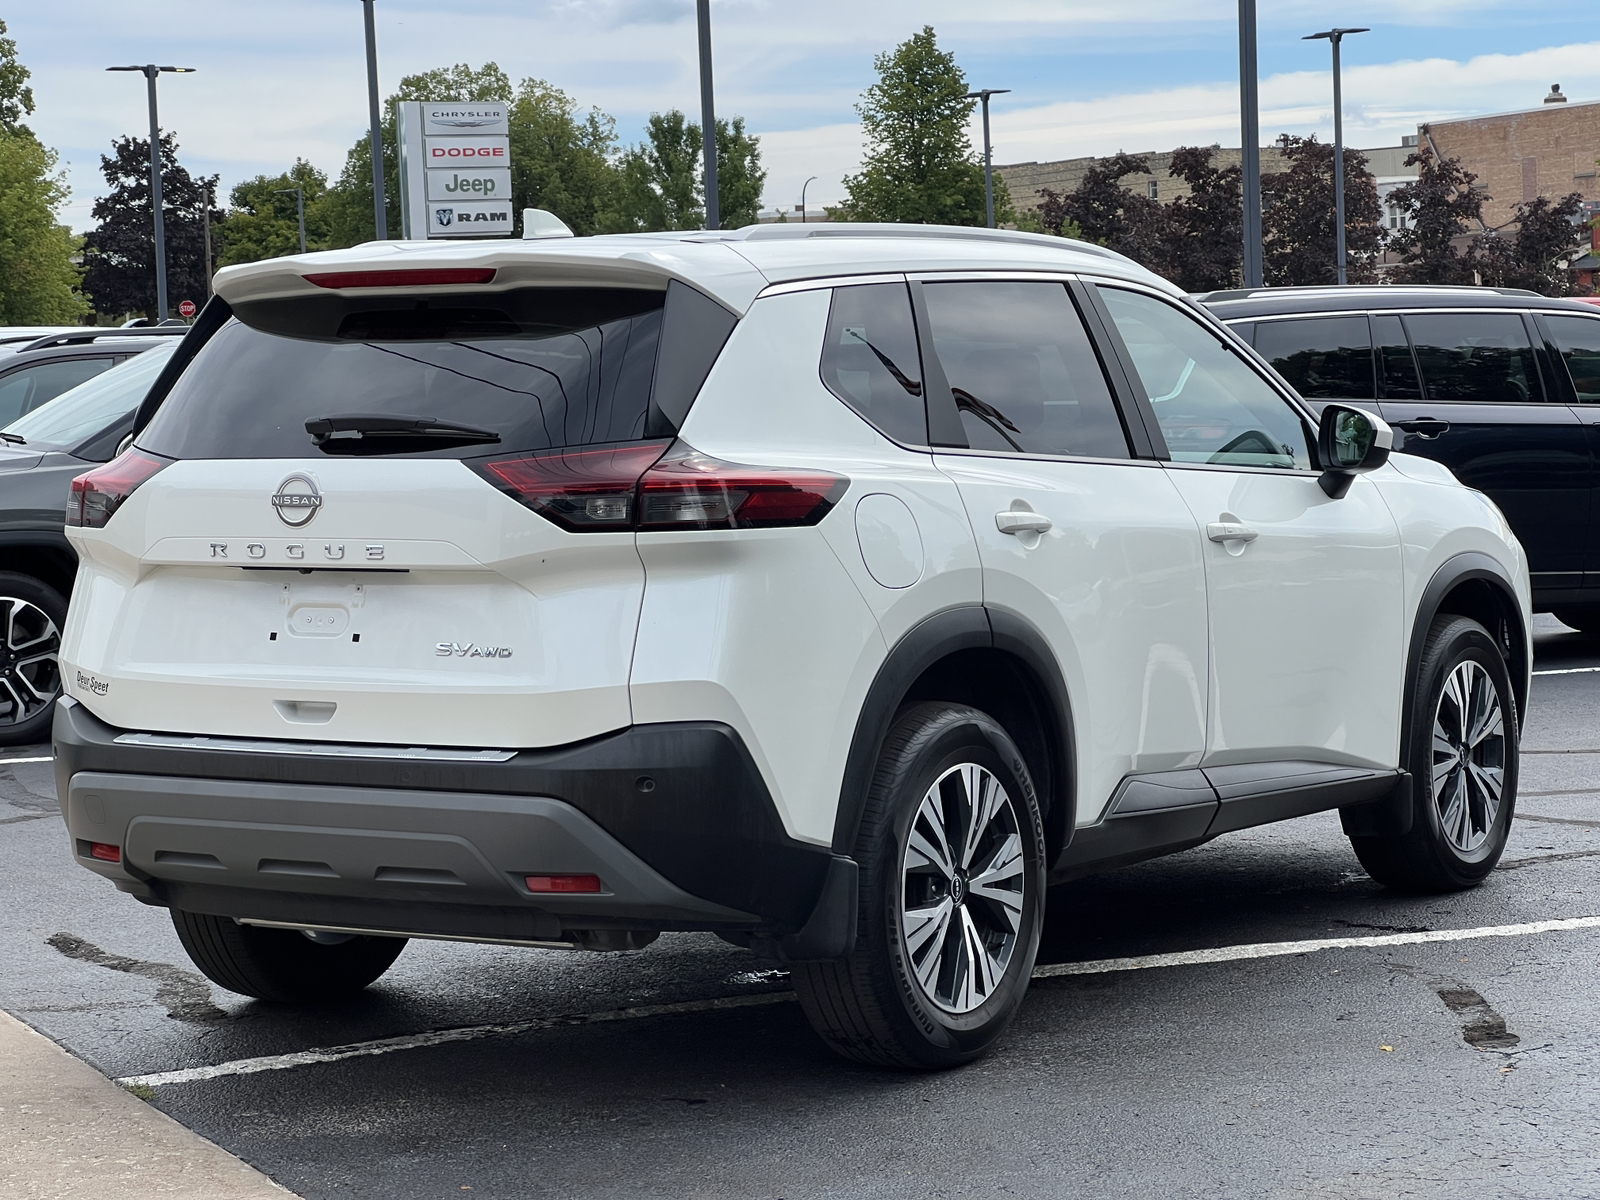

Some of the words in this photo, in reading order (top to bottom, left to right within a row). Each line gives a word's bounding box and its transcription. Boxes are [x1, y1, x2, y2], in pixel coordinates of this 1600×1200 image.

[432, 147, 505, 157] DODGE
[445, 173, 496, 196] Jeep
[457, 212, 508, 222] RAM
[272, 496, 320, 505] NISSAN
[210, 542, 385, 560] ROGUE
